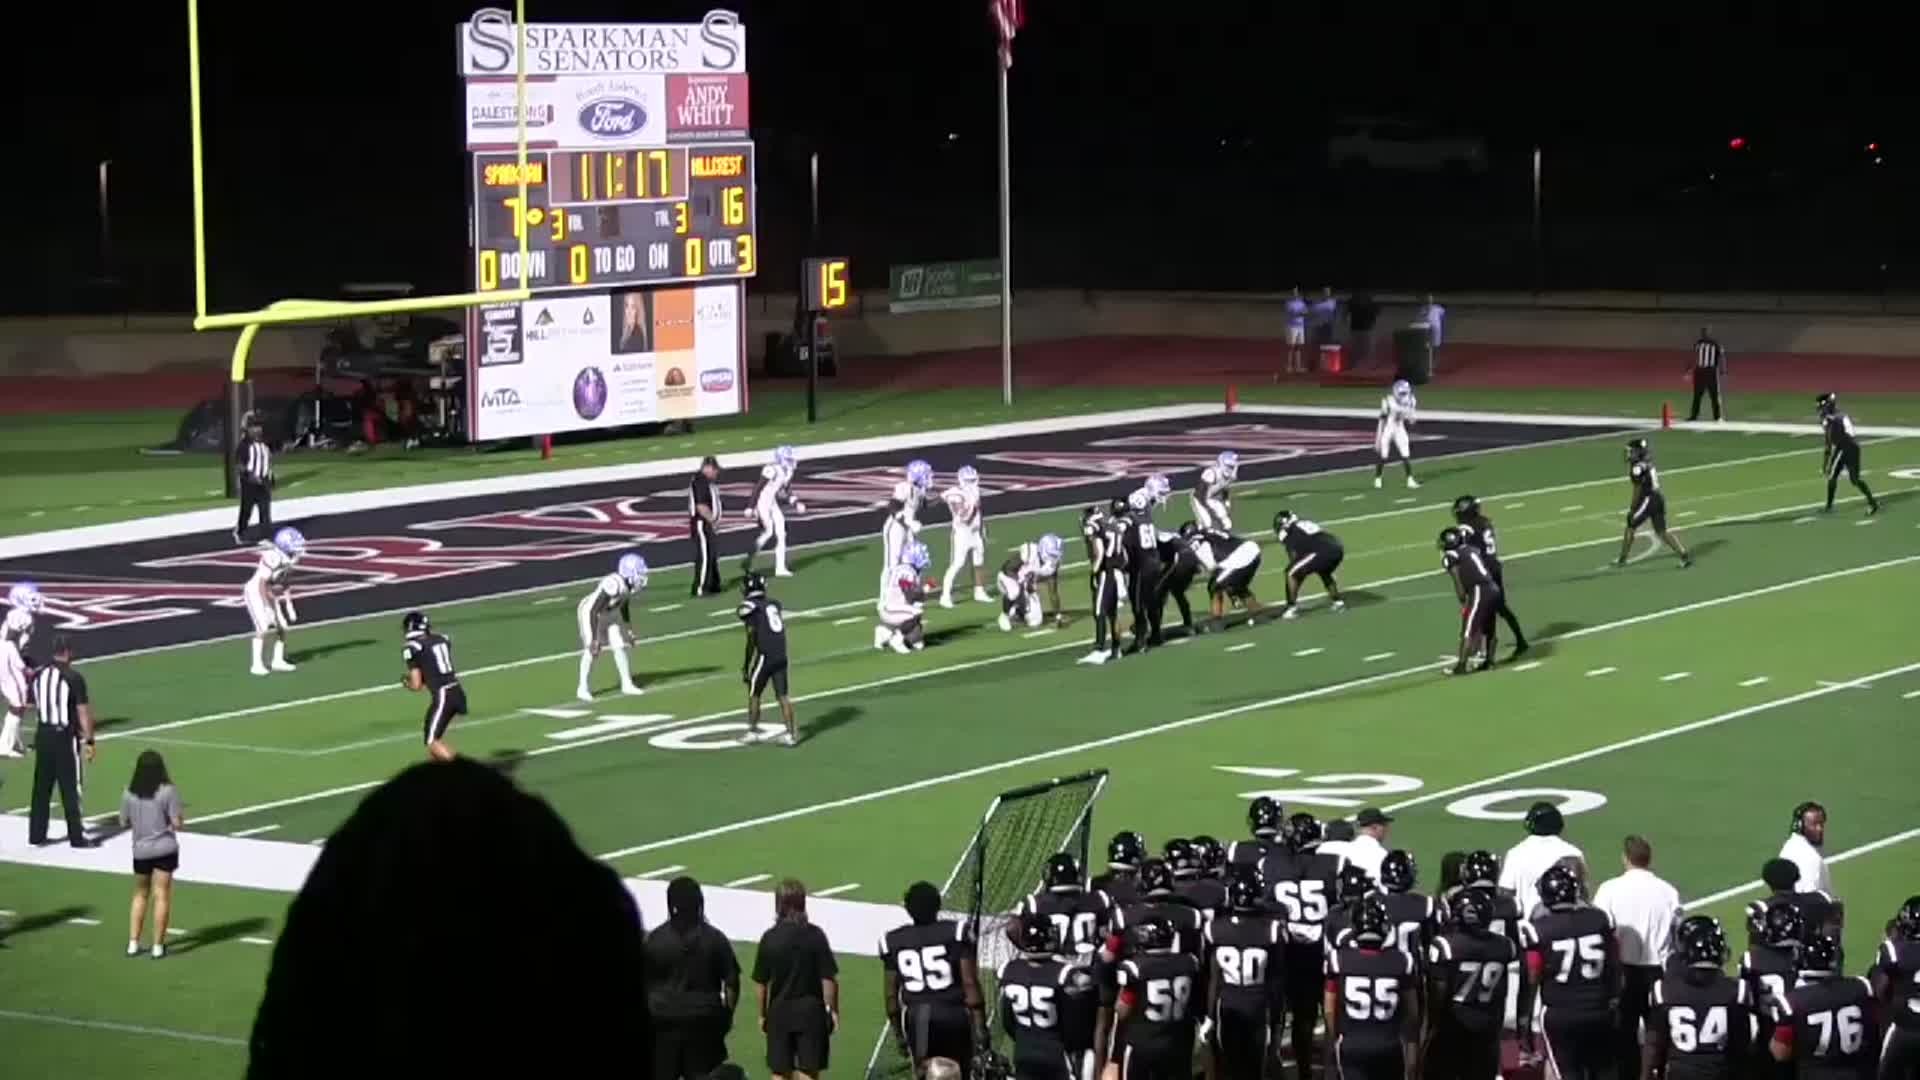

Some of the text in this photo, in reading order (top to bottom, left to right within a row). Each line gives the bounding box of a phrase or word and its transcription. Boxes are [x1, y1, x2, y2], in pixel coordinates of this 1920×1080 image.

[525, 27, 690, 49] SPARKMAN
[538, 49, 680, 71] SENATORS
[472, 103, 546, 121] DALESTRNG
[685, 84, 729, 105] ANDY
[590, 102, 637, 132] Ford
[677, 103, 734, 126] WHITT
[485, 163, 543, 186] SPARKAN
[581, 151, 669, 201] 11:17
[691, 155, 743, 177] HILLCREST
[550, 208, 565, 241] 3
[675, 202, 689, 234] 3
[721, 187, 744, 226] 16
[480, 250, 497, 289] 0
[570, 244, 587, 284] 0
[594, 245, 635, 274] TO GO
[649, 243, 669, 270] ON
[685, 238, 702, 276] 0
[736, 235, 753, 273] 3
[821, 262, 846, 308] 15
[432, 642, 452, 674] 11
[898, 945, 953, 992] 95
[1552, 934, 1605, 983] 75
[1344, 975, 1399, 1021] 55
[1453, 962, 1504, 1002] 79
[1004, 984, 1058, 1028] 25
[1668, 1006, 1728, 1051] 64
[1807, 1004, 1863, 1057] 76
